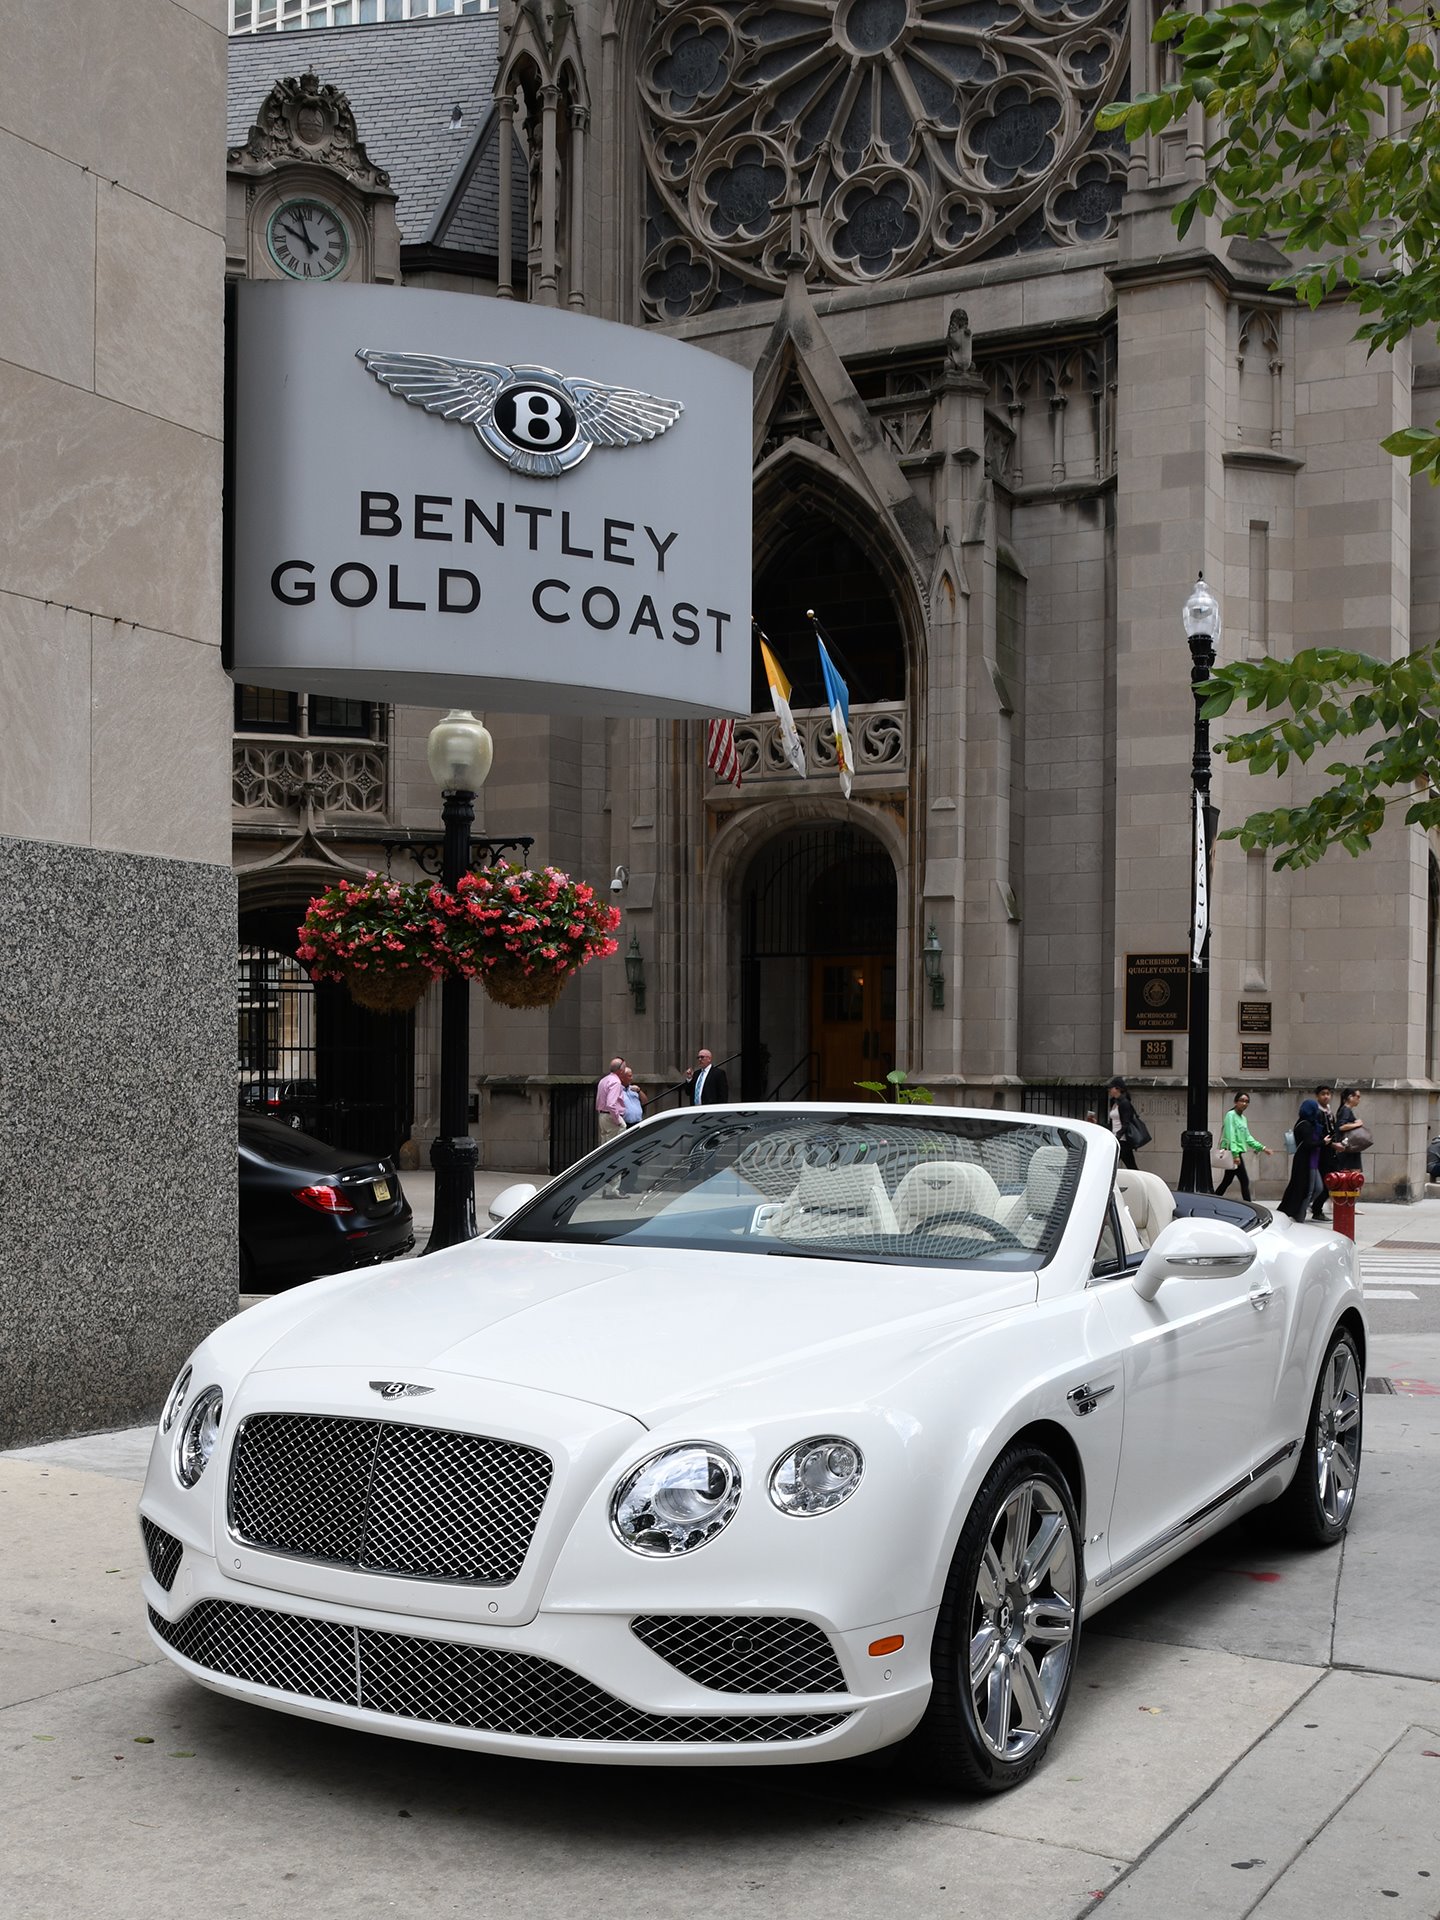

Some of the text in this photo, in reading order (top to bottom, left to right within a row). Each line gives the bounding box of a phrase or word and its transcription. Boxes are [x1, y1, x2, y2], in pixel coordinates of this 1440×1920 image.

[511, 390, 563, 445] B
[360, 490, 679, 572] BENTLEY
[270, 560, 732, 653] GOLD COAST
[1128, 966, 1187, 975] QUIGLEY CENTER
[1135, 958, 1180, 966] ARCHBISHOP
[1146, 1041, 1167, 1054] 835
